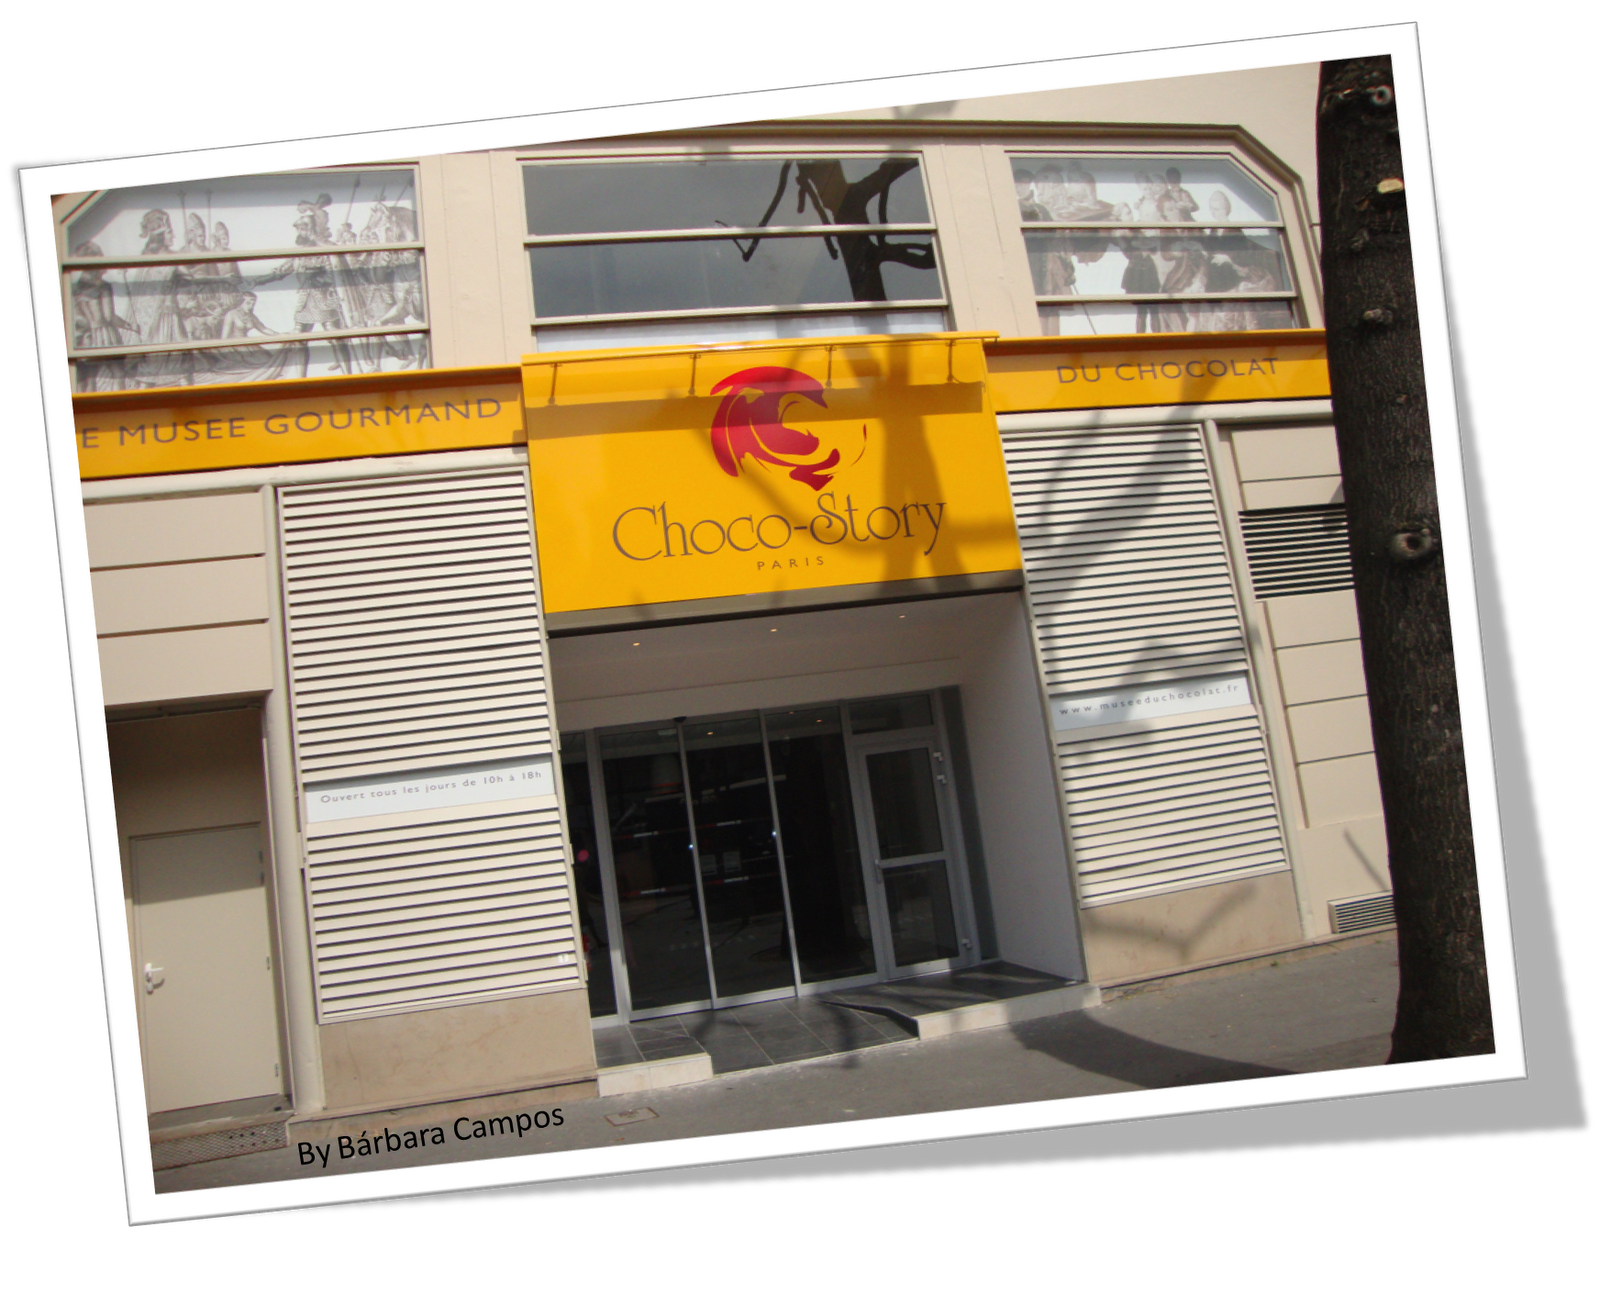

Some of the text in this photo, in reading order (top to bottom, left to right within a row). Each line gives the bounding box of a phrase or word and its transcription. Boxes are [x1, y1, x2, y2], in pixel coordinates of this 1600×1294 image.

[1056, 357, 1279, 384] DU CHOCOLAT
[118, 417, 246, 447] MUSEE
[264, 397, 502, 435] GOURMAND
[612, 491, 947, 561] Choco-Story
[757, 556, 824, 570] PARIS
[1059, 684, 1239, 716] www.museeduchocolat.fr
[320, 770, 542, 804] Ouvert tous les jours de 10h à 18h
